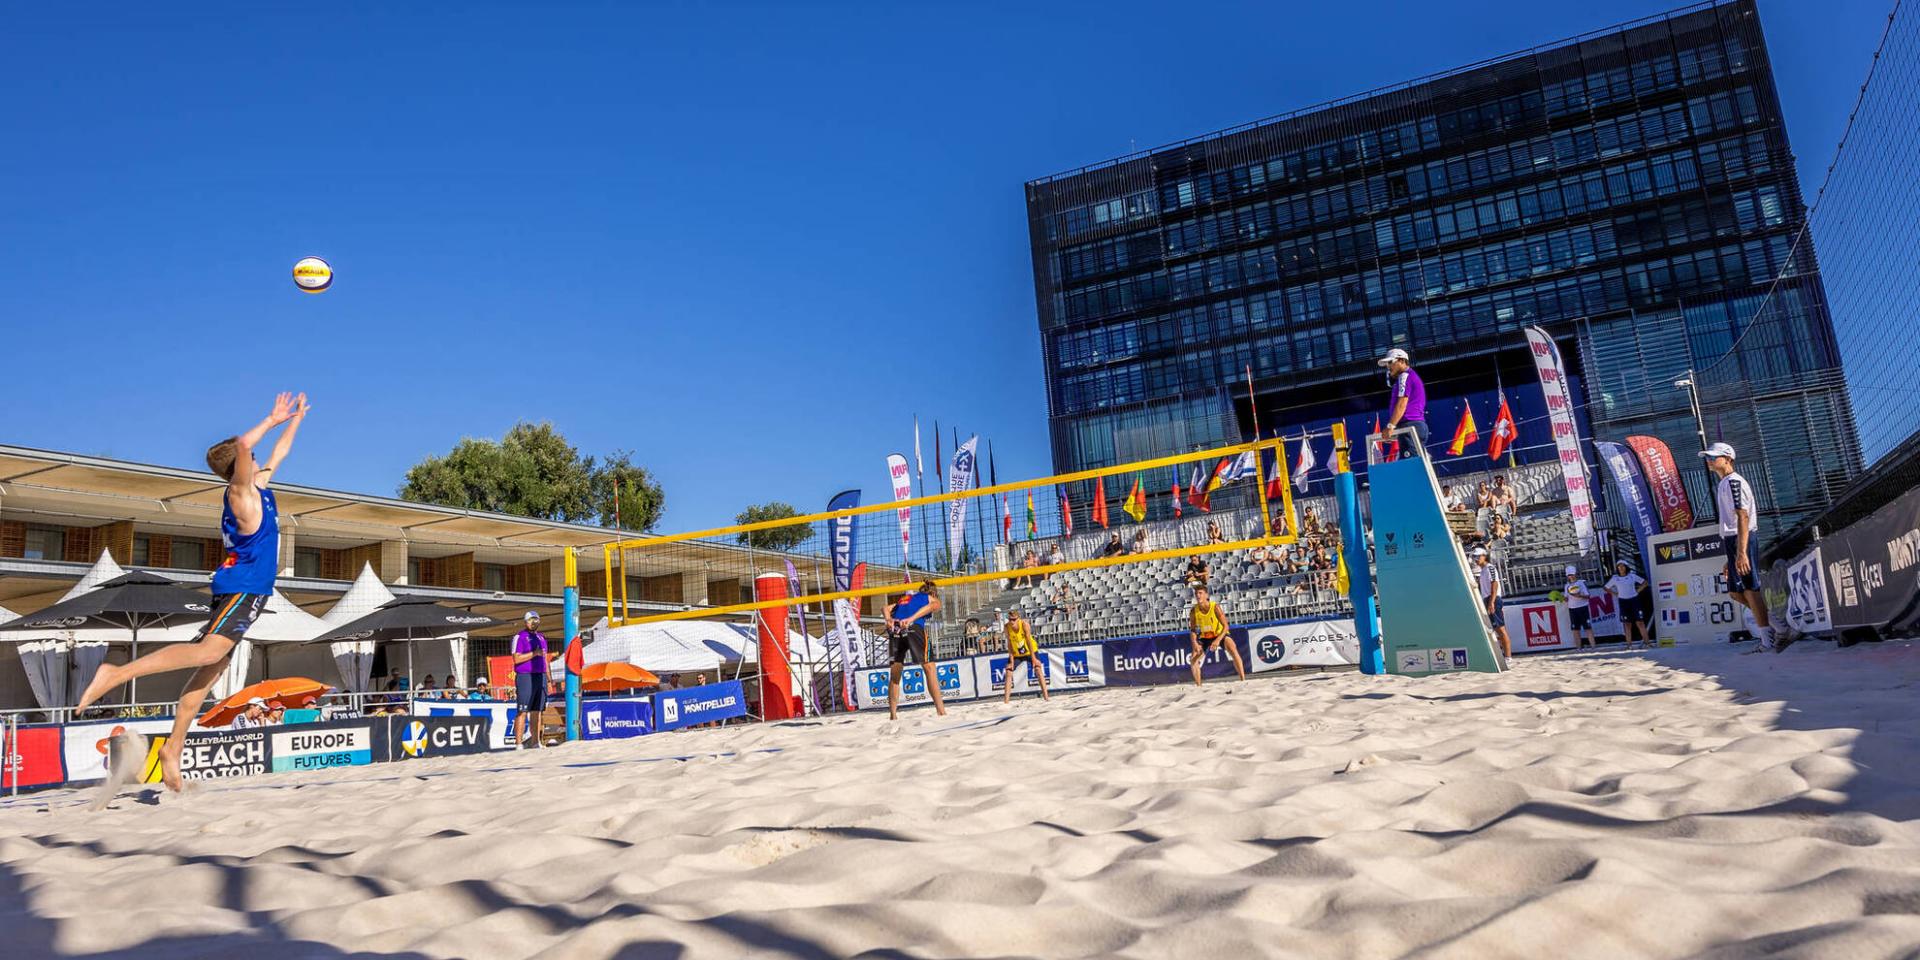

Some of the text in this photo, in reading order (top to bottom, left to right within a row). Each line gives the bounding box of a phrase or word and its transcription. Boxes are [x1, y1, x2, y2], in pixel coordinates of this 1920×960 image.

[1705, 542, 1721, 550] CEV
[1711, 601, 1734, 624] 20
[1529, 610, 1553, 634] N
[1293, 633, 1358, 645] PRADES-M
[1529, 635, 1558, 645] NICOLLIN
[1293, 645, 1360, 655] CAPIT
[1069, 661, 1085, 674] M
[684, 697, 736, 714] MONTPELLIER
[184, 733, 264, 746] OLLEYBALL WORLD
[291, 733, 354, 750] EUROPE
[433, 724, 480, 747] CEV
[180, 741, 264, 770] BEACH
[295, 754, 352, 768] FUTURES
